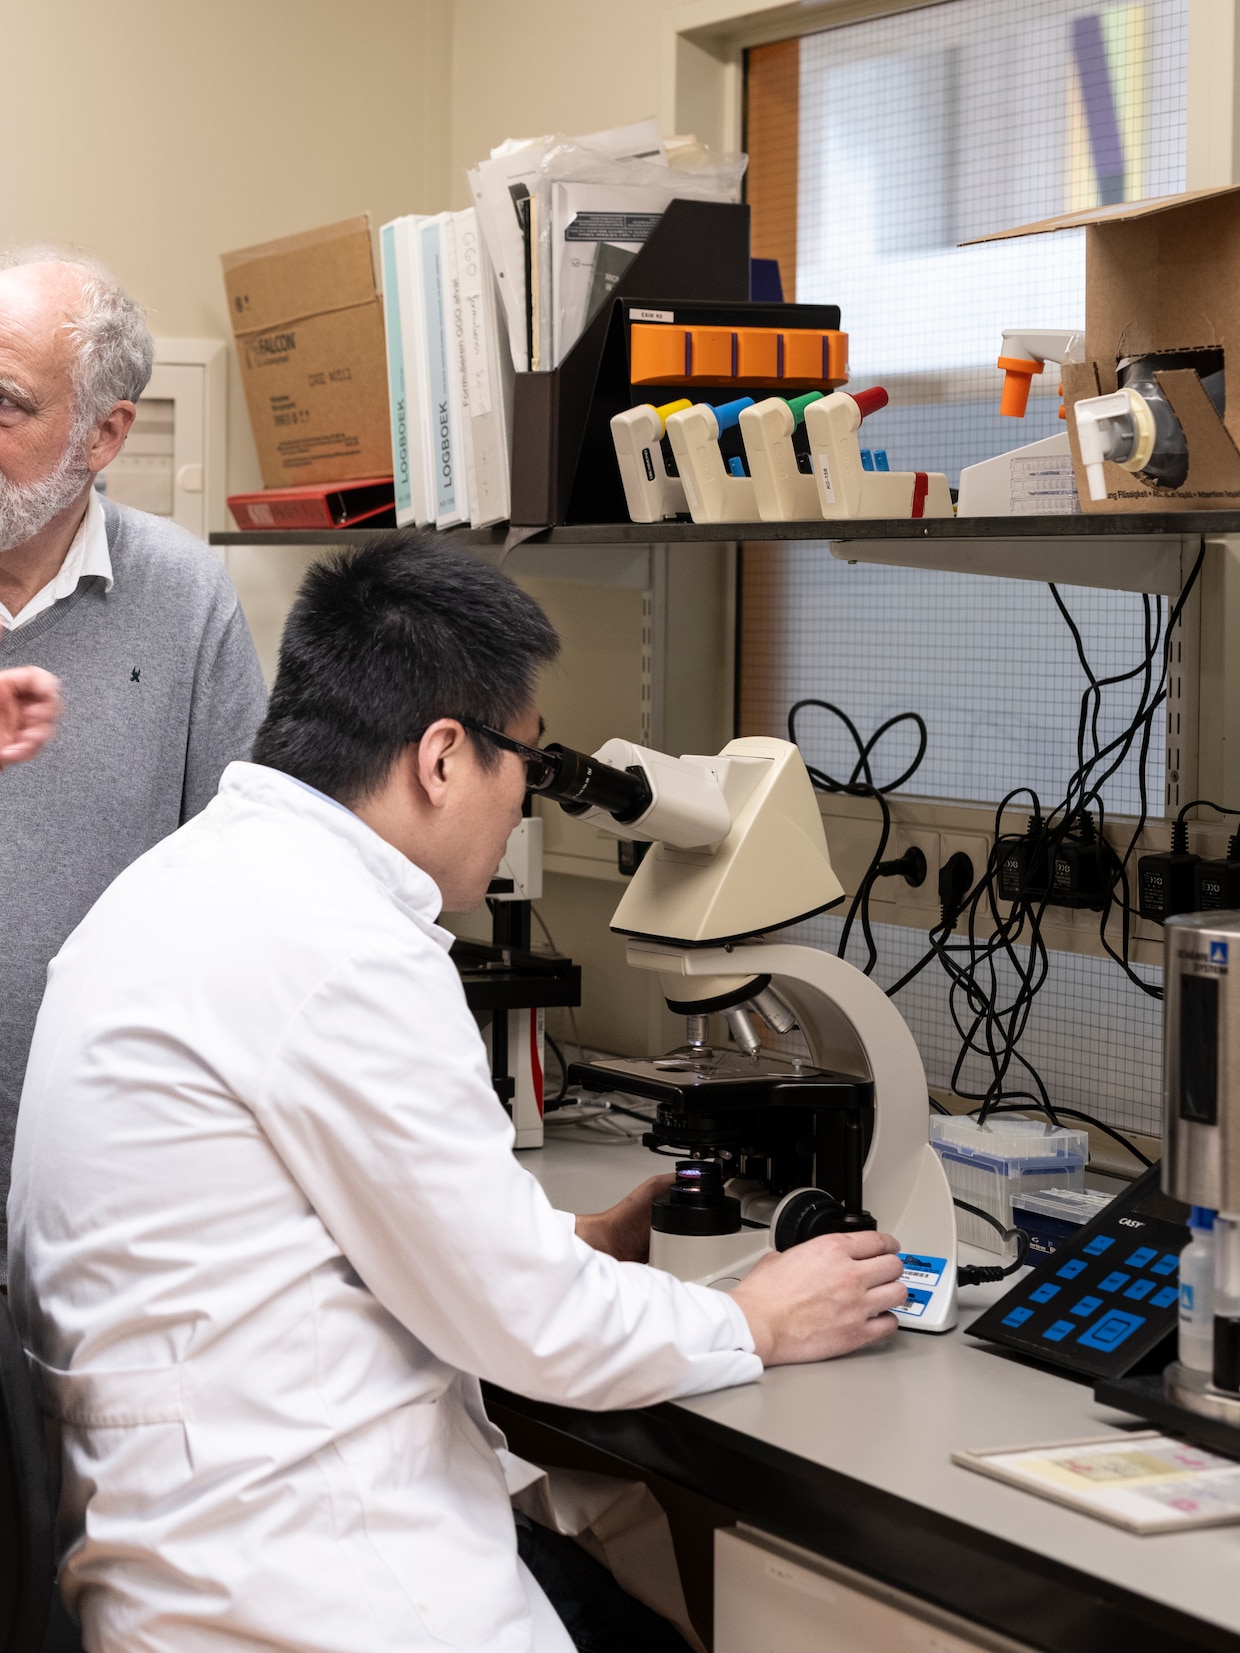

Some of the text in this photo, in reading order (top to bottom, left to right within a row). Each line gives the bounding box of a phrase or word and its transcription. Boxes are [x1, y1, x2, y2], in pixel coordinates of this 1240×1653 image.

[396, 397, 409, 484] LOGBOEK
[438, 400, 453, 488] LOGBOEK
[1118, 490, 1149, 500] Flüssigkeit
[1118, 1217, 1142, 1229] CASY
